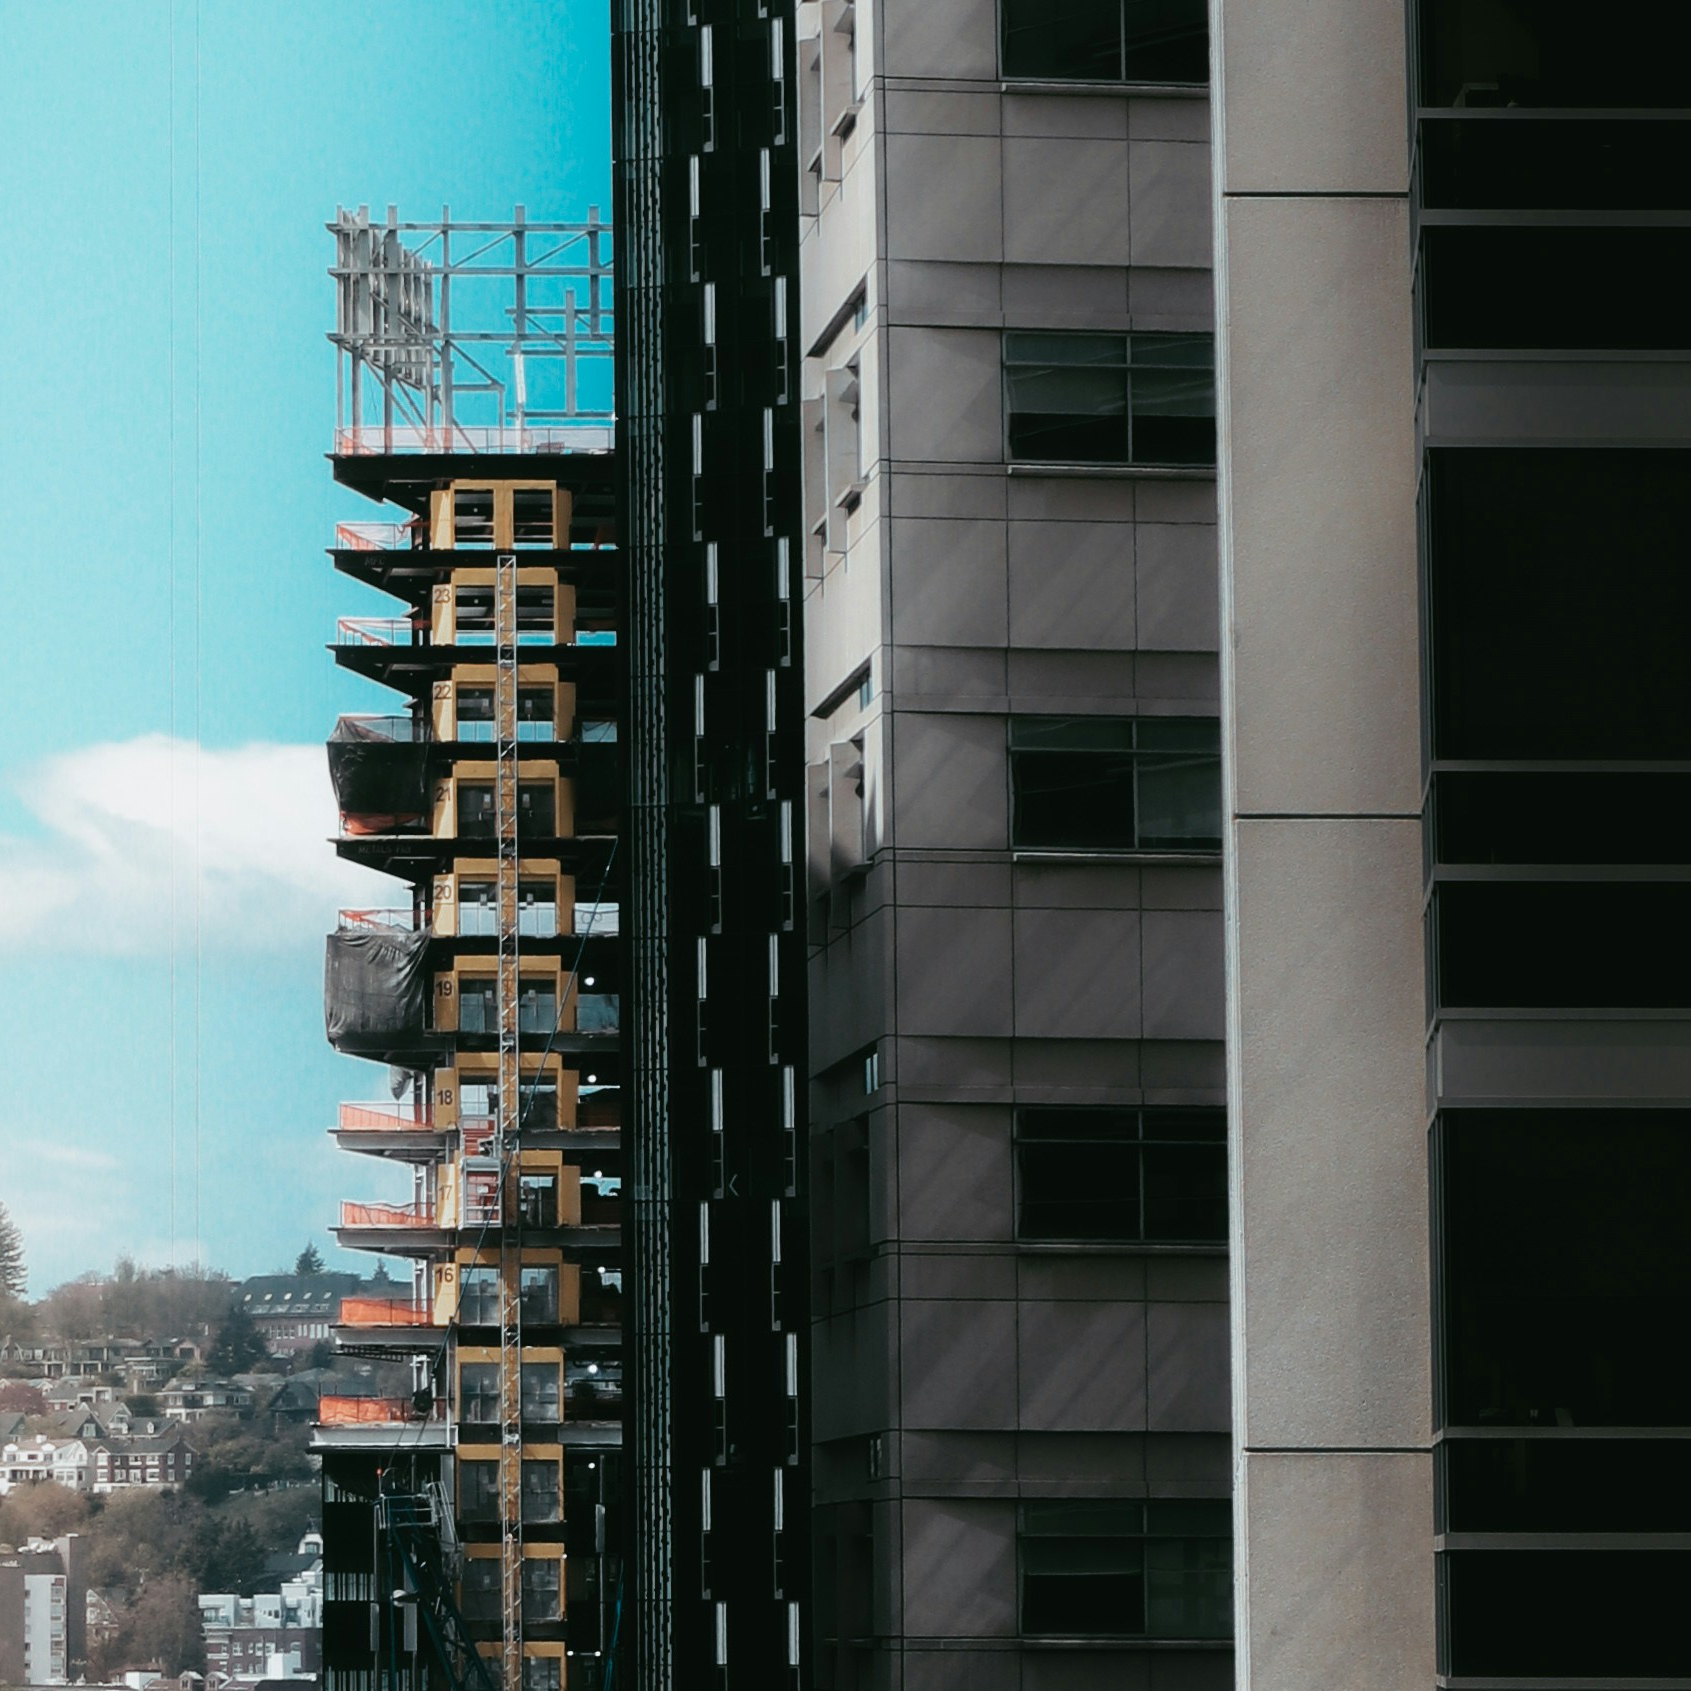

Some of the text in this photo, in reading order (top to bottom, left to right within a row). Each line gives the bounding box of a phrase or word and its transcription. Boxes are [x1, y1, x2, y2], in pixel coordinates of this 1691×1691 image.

[434, 589, 451, 604] 23
[434, 685, 452, 700] 22
[436, 786, 451, 802] 21
[435, 885, 452, 900] 20
[436, 980, 453, 997] 19
[437, 1089, 453, 1106] 18
[438, 1185, 452, 1201] 17
[435, 1267, 454, 1283] 16
